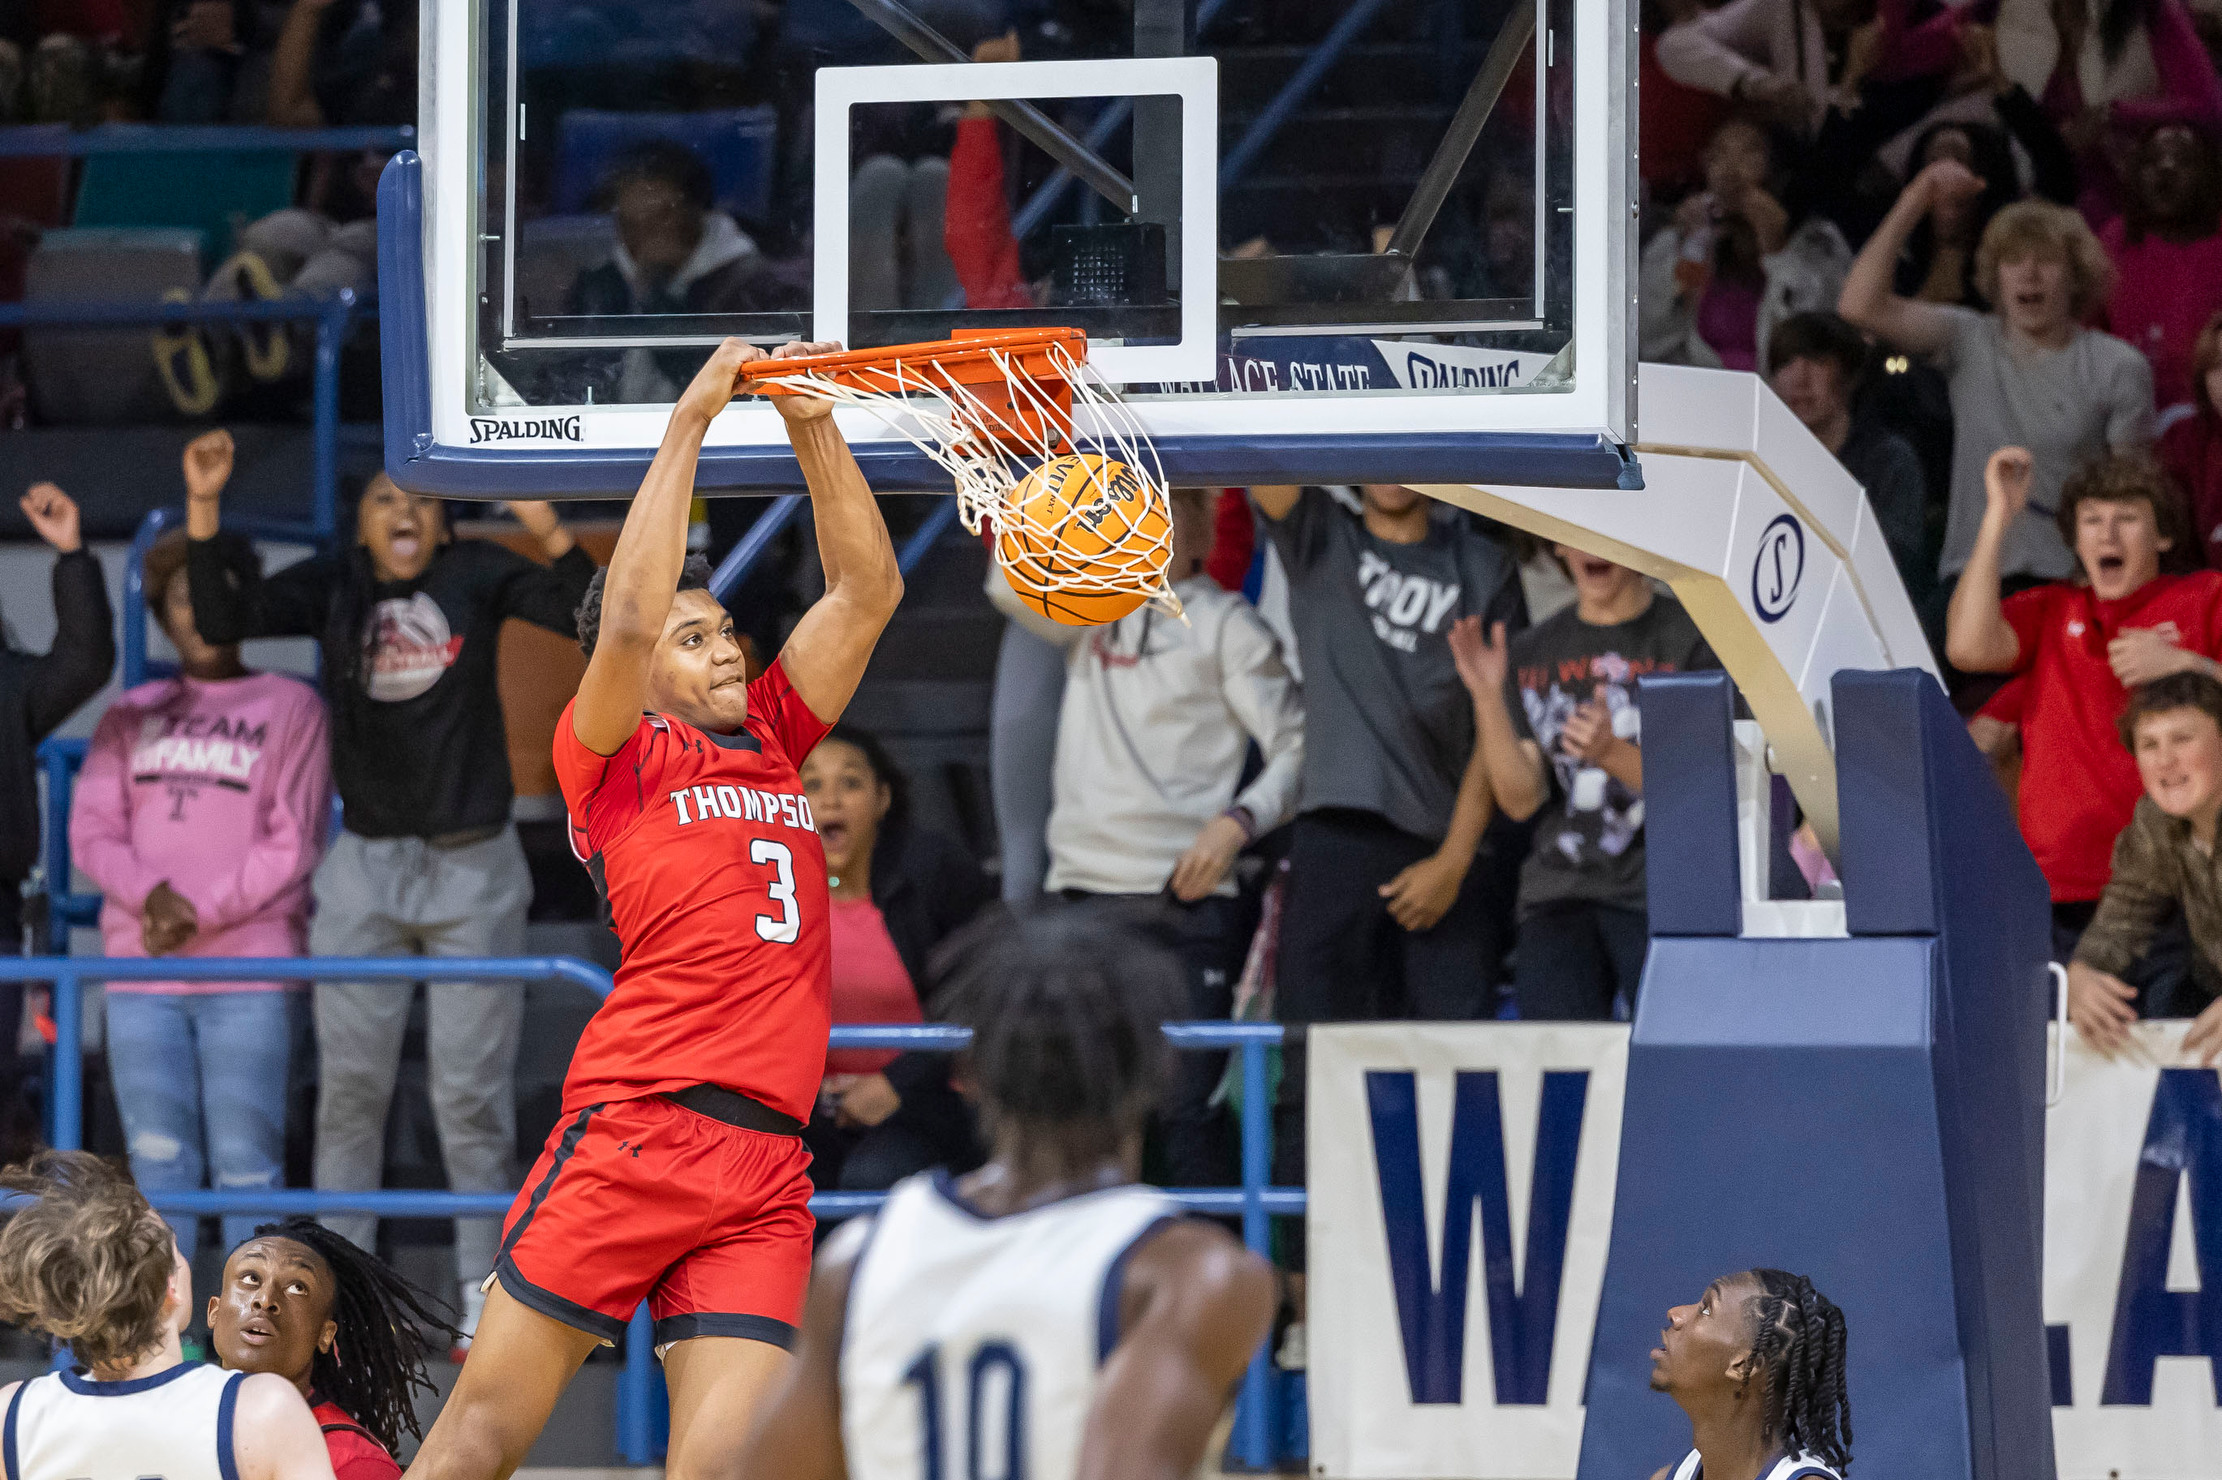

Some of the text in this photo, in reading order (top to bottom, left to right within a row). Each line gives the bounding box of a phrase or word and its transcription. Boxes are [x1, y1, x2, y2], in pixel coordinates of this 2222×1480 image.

[470, 415, 580, 444] SPALDING
[669, 785, 819, 835] THOMPSO
[750, 838, 800, 945] 3
[900, 1336, 1034, 1480] 10
